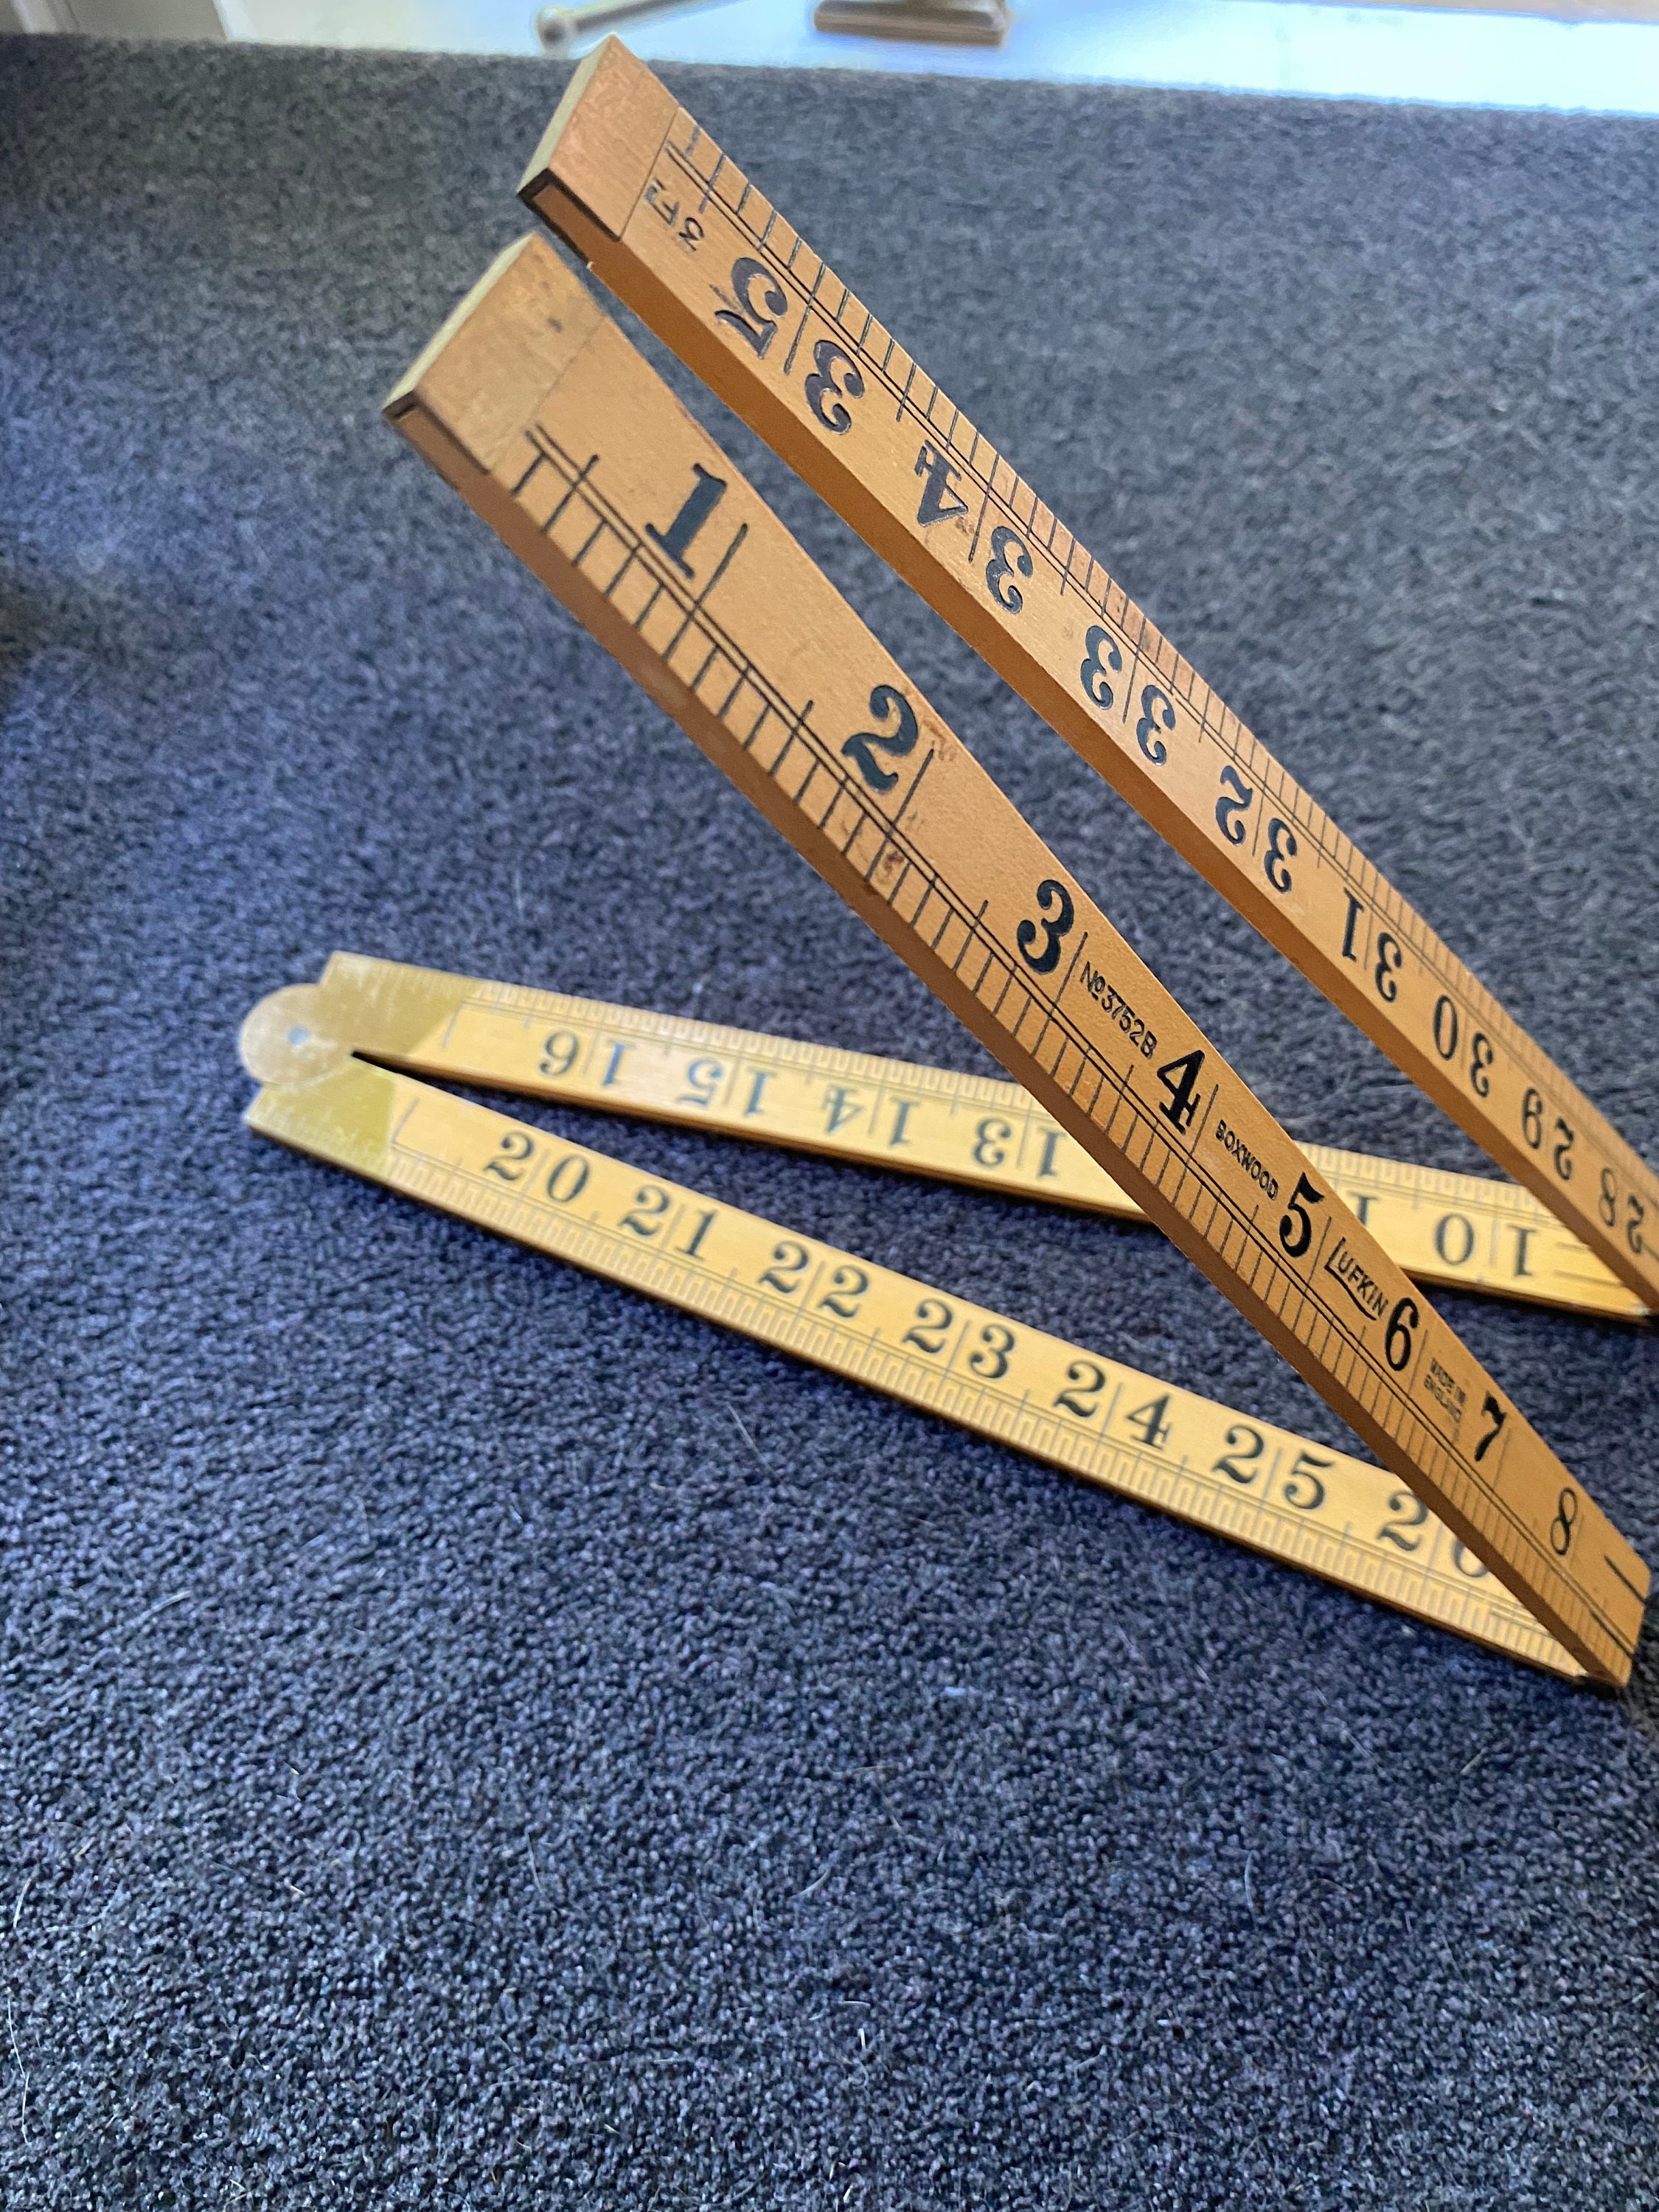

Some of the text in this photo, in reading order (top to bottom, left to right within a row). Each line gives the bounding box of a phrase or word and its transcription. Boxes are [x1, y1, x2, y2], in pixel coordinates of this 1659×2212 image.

[714, 257, 1644, 1253] 28 29 30 31 32 33 34 35
[644, 462, 727, 580] 1
[841, 684, 919, 793] 2
[1017, 879, 1074, 975] 3
[1156, 1049, 1206, 1135] 4
[1215, 1119, 1279, 1200] BOXWOOD
[1279, 1172, 1324, 1257] 5
[1324, 1237, 1388, 1321] LUFKIN
[1384, 1297, 1419, 1371] 6
[539, 1030, 638, 1087] 16
[675, 1058, 777, 1118] 15
[822, 1084, 922, 1148] 14
[973, 1116, 1067, 1178] 13
[1433, 1212, 1537, 1279] 10
[484, 1131, 591, 1203] 20
[618, 1184, 720, 1262] 21
[758, 1240, 869, 1318] 22
[902, 1298, 1016, 1379] 23
[1053, 1360, 1173, 1450] 24
[1211, 1425, 1334, 1510] 25
[1475, 1390, 1578, 1556] 7 8
